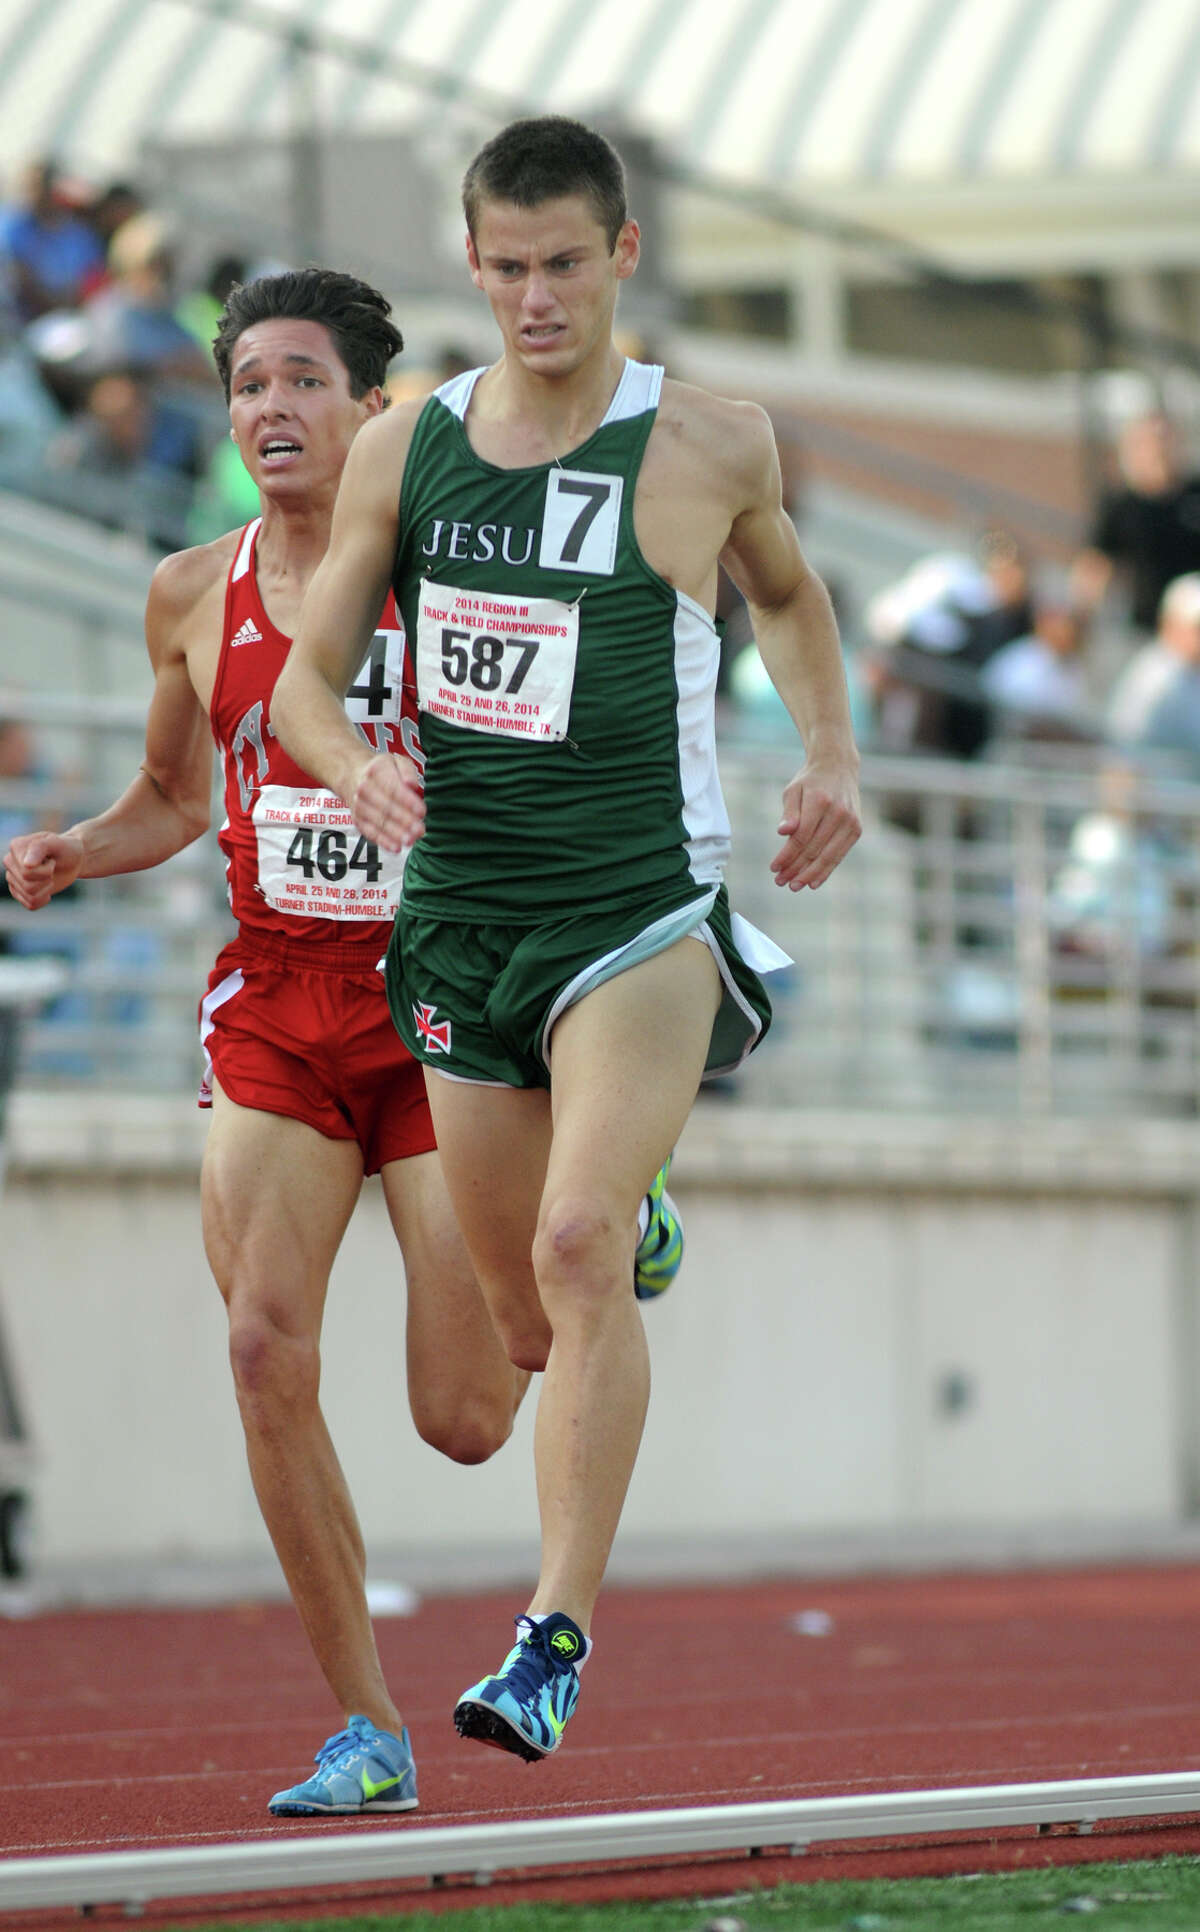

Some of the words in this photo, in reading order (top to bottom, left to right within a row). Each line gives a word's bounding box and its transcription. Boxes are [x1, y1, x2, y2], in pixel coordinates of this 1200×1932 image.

[557, 478, 611, 564] 7
[422, 519, 536, 565] JESU
[424, 605, 448, 621] TRACK
[451, 613, 458, 623] &
[461, 615, 484, 628] FIELD
[486, 619, 568, 638] CHAMPIONSHIPS
[455, 598, 479, 609] 2014
[482, 603, 517, 616] REGION
[520, 607, 529, 617] III
[231, 632, 263, 647] adidas
[441, 628, 540, 695] 587
[438, 688, 457, 703] APRIL
[460, 694, 472, 705] 25
[474, 697, 492, 710] AND
[495, 700, 511, 714] 26,
[514, 703, 540, 716] 2014
[427, 700, 455, 718] TURNER
[540, 723, 551, 735] TX
[299, 796, 321, 807] 2014
[265, 809, 291, 822] TRACK
[303, 813, 326, 824] FIELD
[286, 827, 383, 882] 464
[275, 897, 305, 911] TURNER
[285, 883, 308, 895] APRIL
[311, 885, 323, 896] 25
[326, 887, 341, 898] AND
[362, 889, 388, 899] 2014
